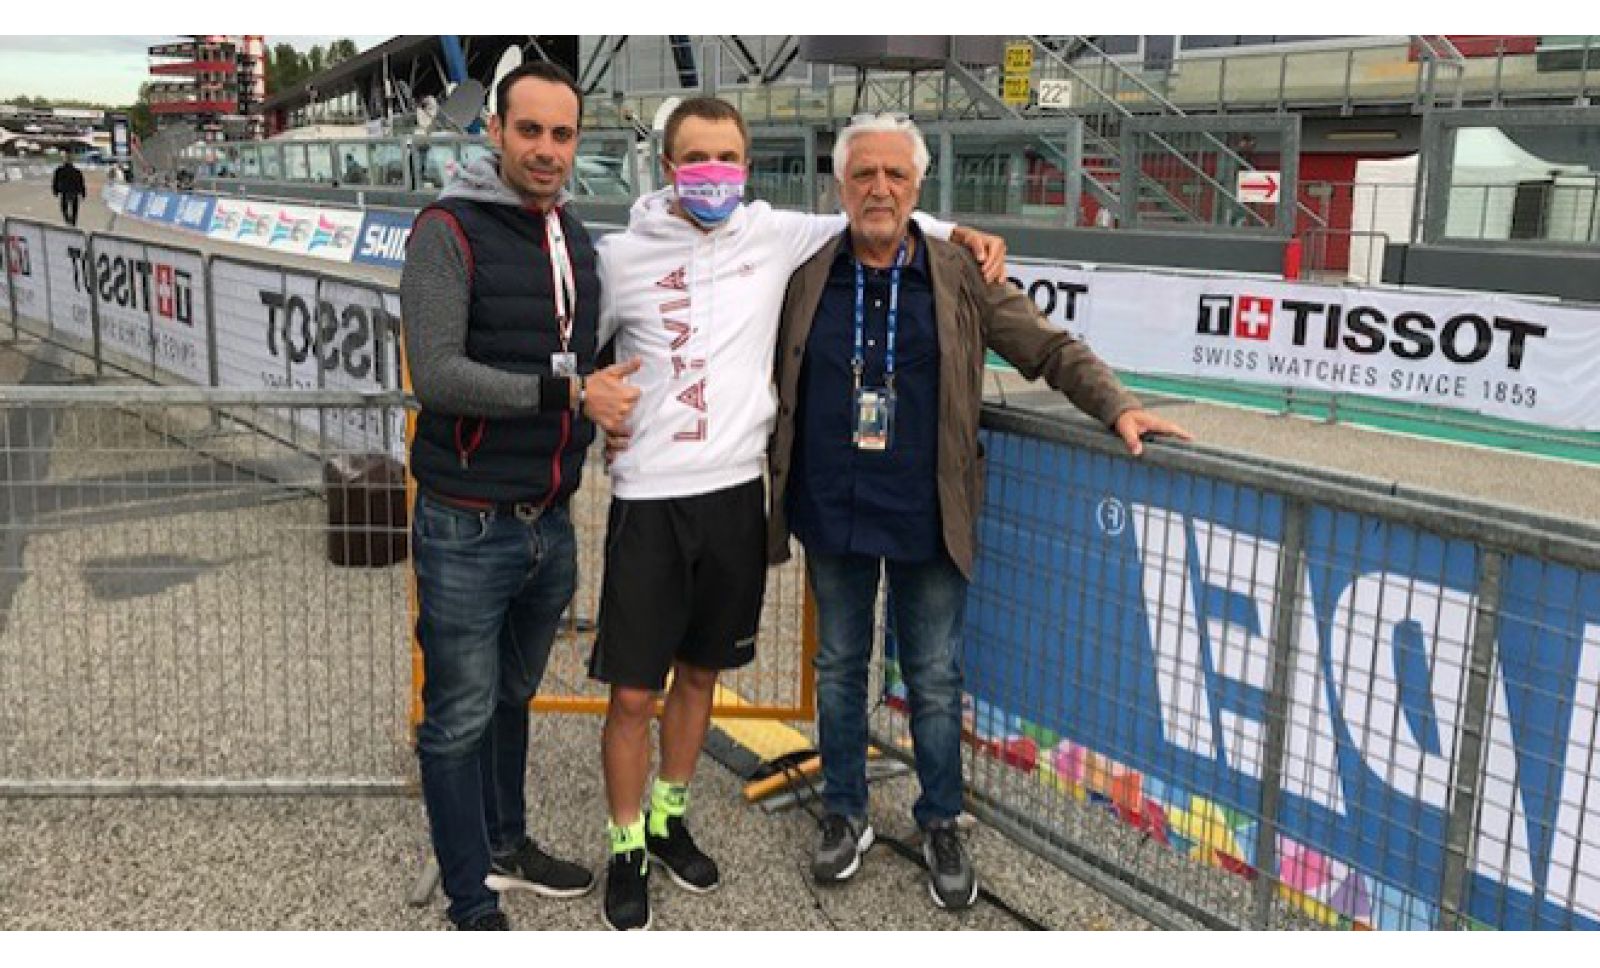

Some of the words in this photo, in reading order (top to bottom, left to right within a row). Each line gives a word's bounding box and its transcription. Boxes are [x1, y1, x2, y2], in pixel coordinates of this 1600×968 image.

[1006, 276, 1088, 321] OT
[655, 265, 708, 442] LATVIA
[1282, 299, 1548, 370] TISSOT
[1192, 346, 1259, 371] SWISS
[1268, 354, 1378, 387] WATCHES
[1389, 369, 1467, 398] SINCE
[1483, 380, 1538, 409] 1853
